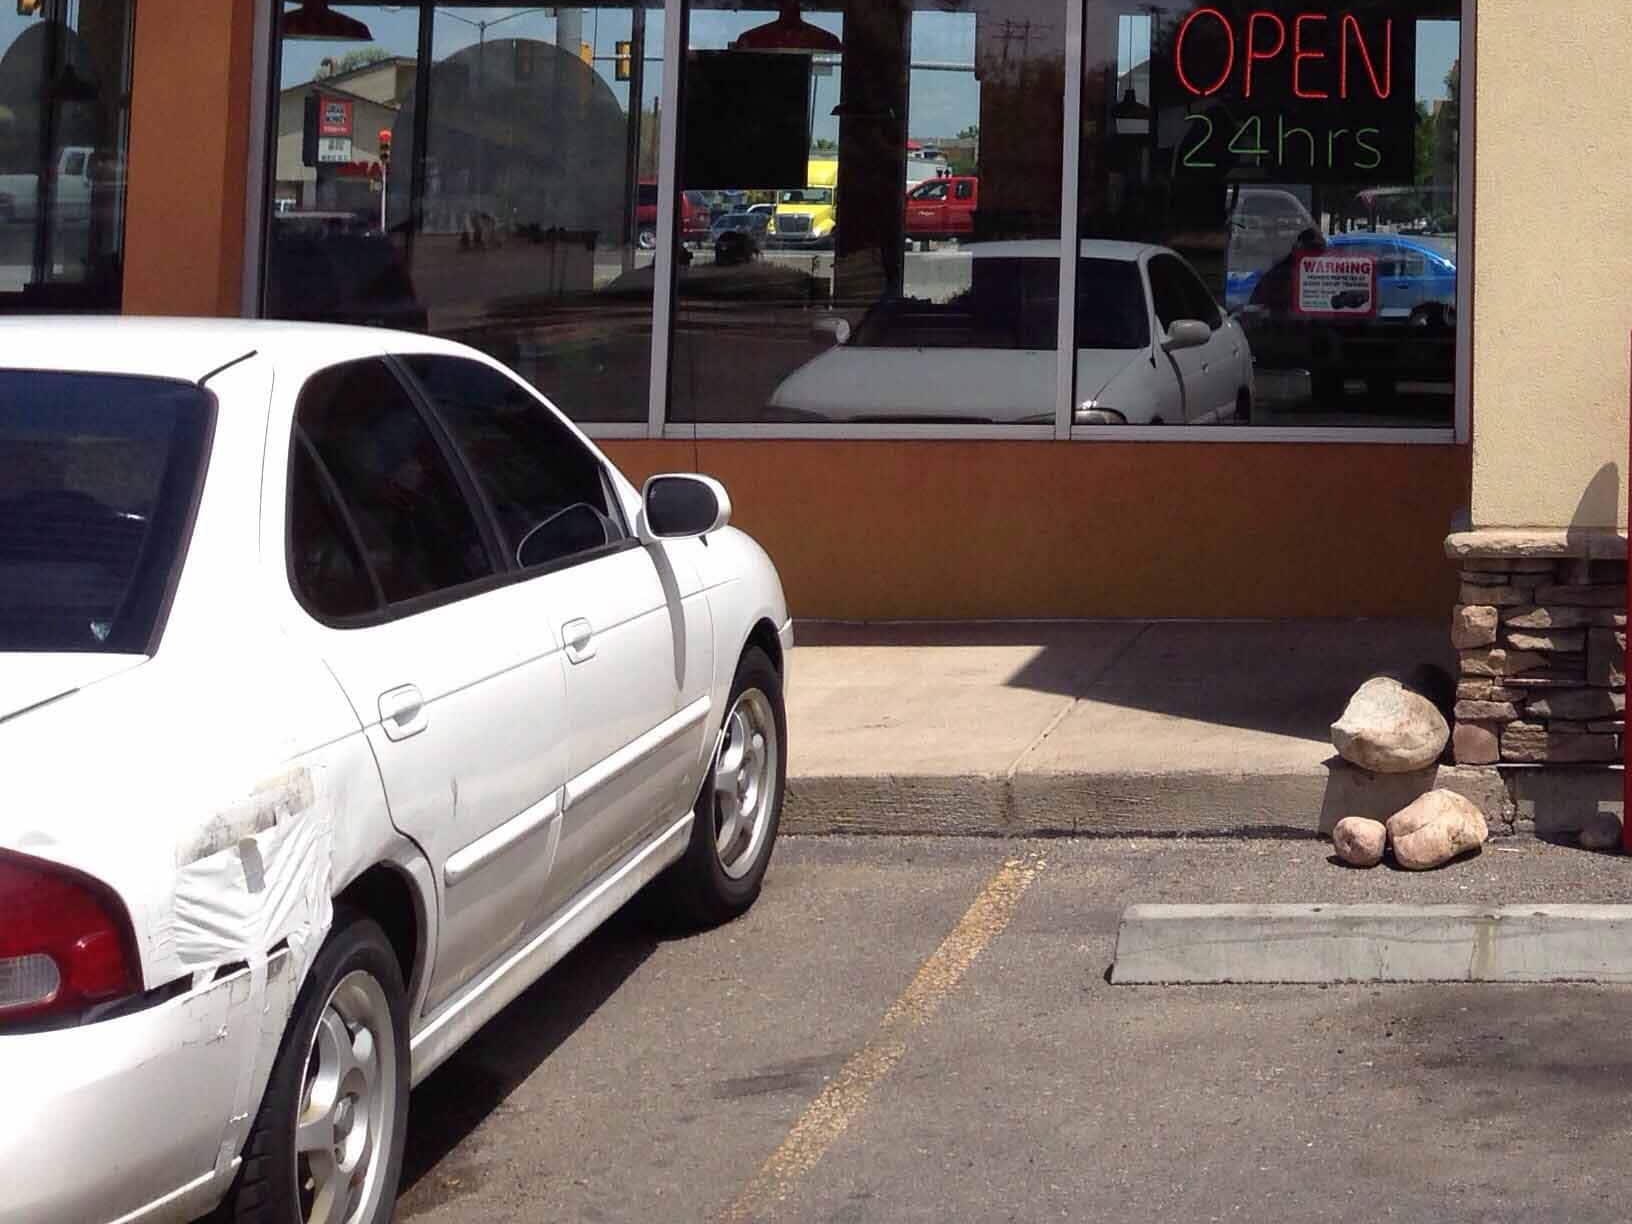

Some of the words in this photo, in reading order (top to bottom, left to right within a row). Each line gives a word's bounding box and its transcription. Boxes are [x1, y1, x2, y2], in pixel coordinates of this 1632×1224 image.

[1175, 7, 1393, 99] OPEN
[1183, 114, 1382, 169] 24hrs
[1303, 260, 1371, 275] WARNING
